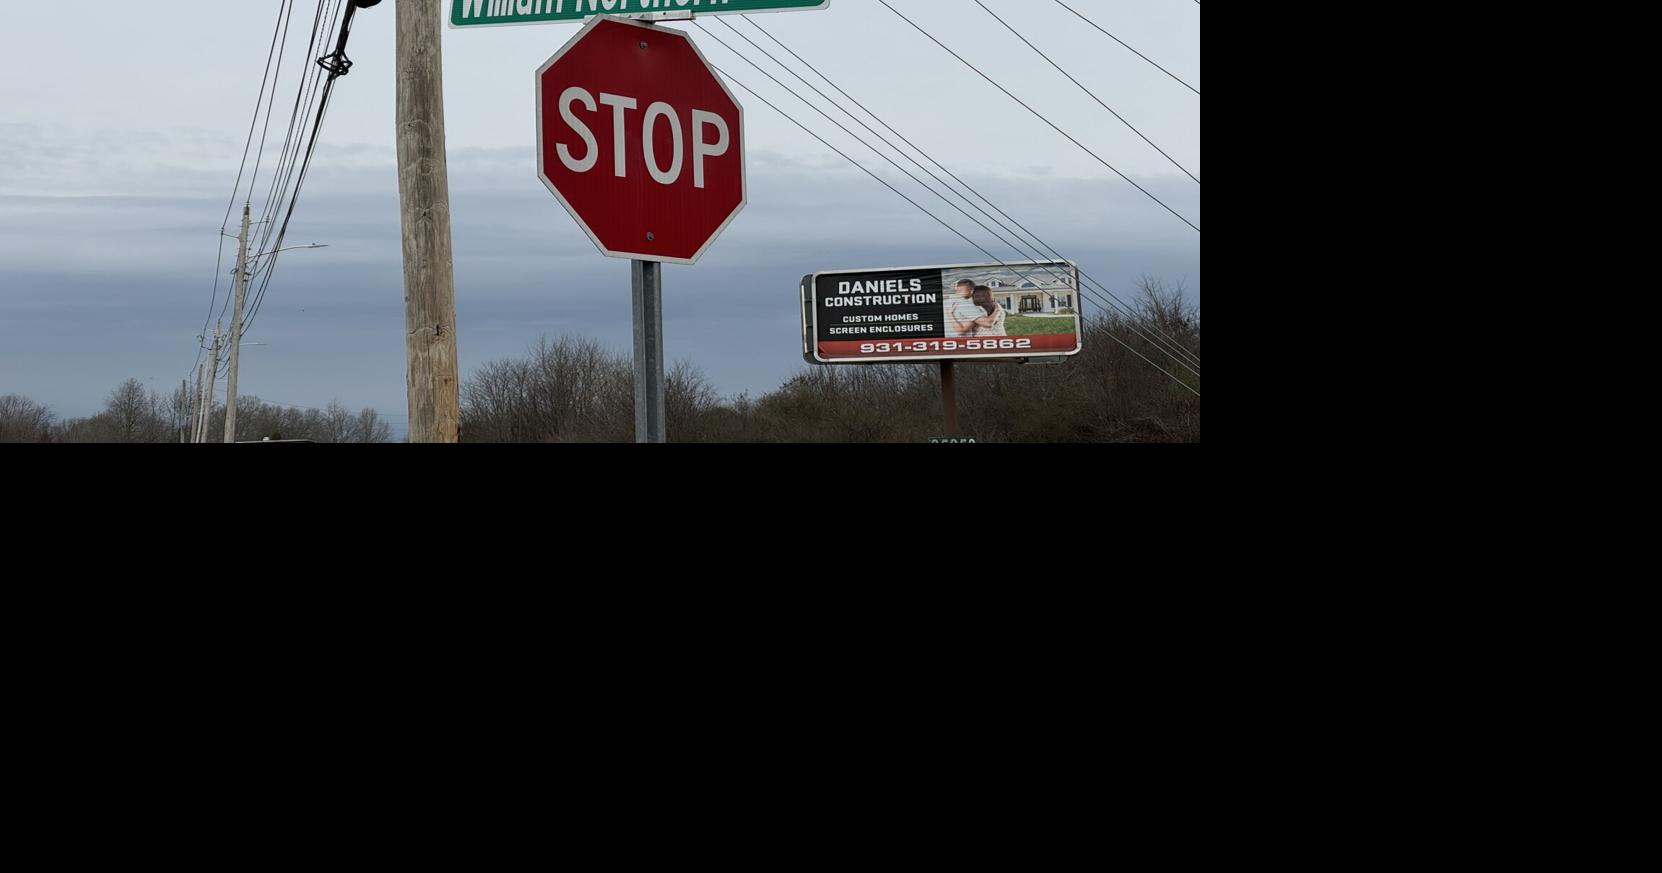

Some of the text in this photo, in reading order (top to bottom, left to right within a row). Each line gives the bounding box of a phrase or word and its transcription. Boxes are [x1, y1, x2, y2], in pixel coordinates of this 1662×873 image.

[555, 86, 730, 189] STOP
[838, 278, 922, 295] DANIELS
[824, 293, 937, 307] CONSTRUCTION
[842, 313, 919, 323] CUSTOM HOMES
[829, 324, 934, 335] SCREEN ENCLOSURES
[860, 338, 1032, 353] 931-319-5862
